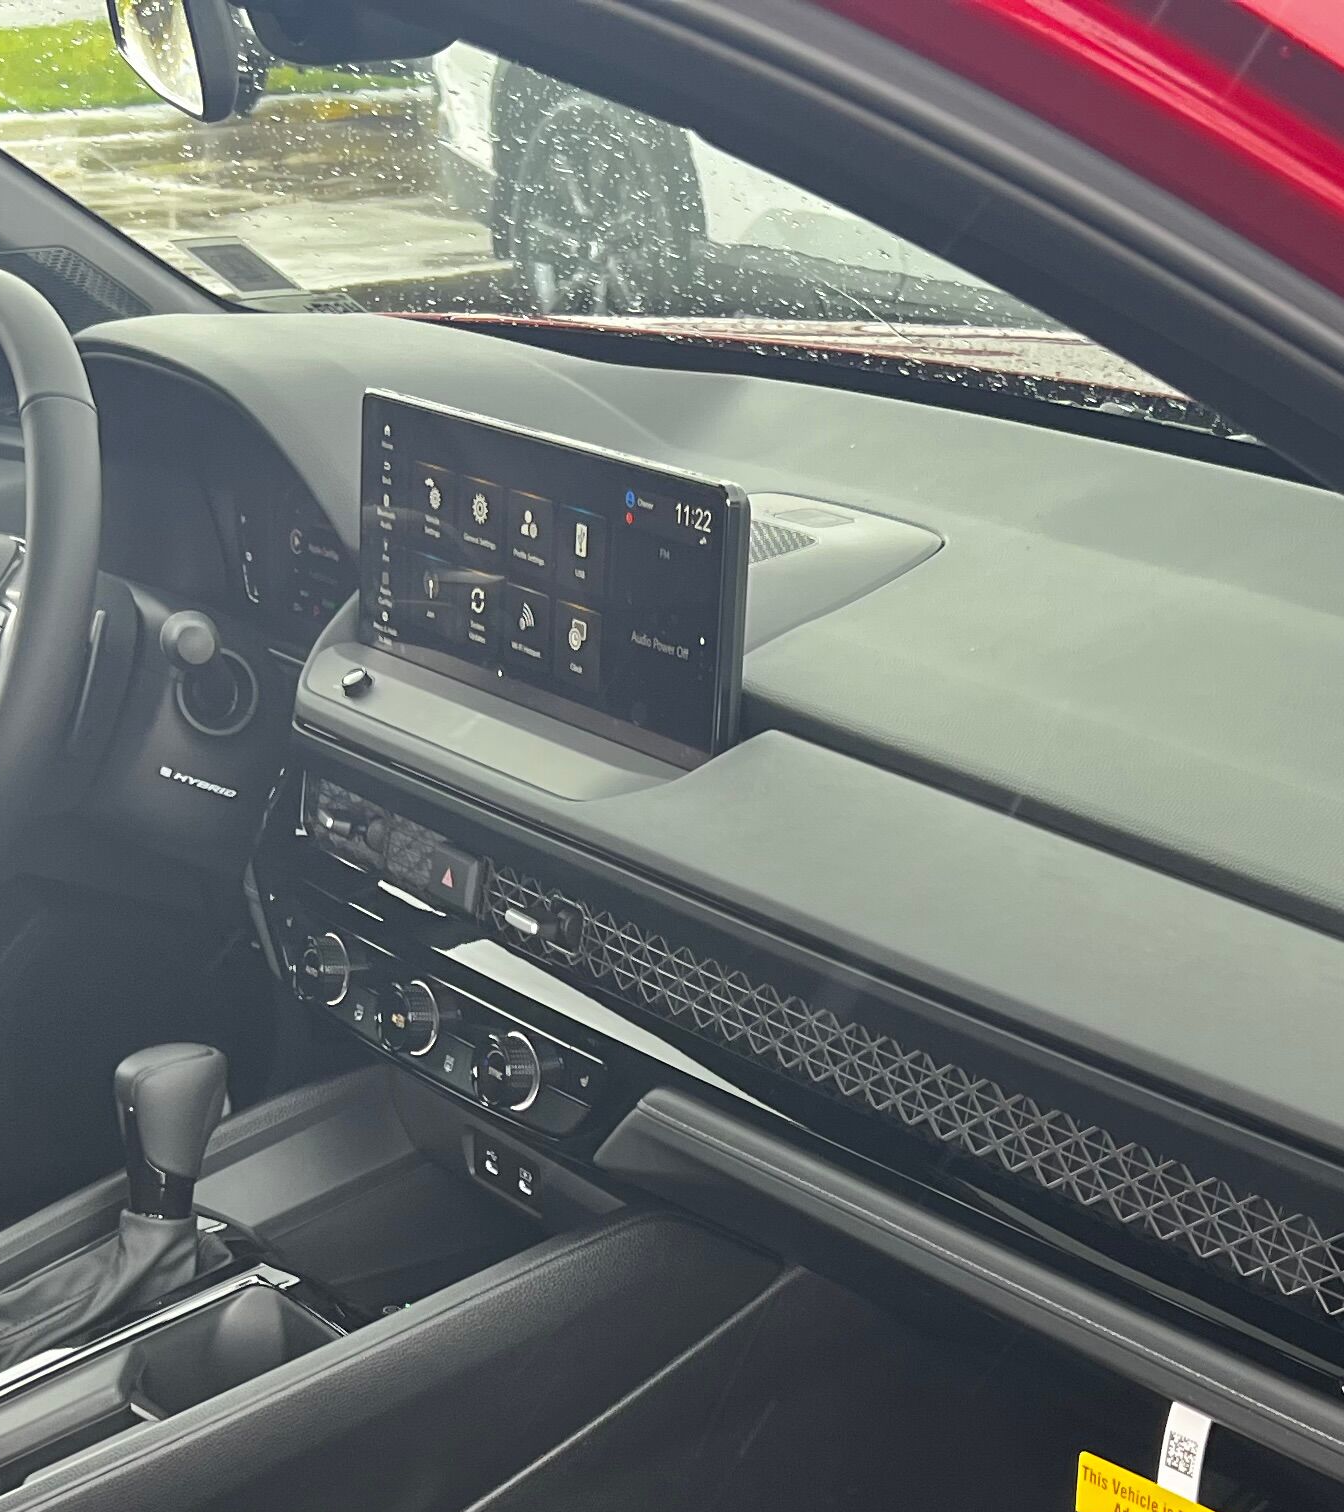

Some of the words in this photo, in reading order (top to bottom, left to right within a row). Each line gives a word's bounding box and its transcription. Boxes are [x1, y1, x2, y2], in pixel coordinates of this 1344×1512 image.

[675, 502, 712, 533] 11:22
[631, 630, 651, 649] Audio
[653, 637, 675, 656] Power
[676, 645, 689, 661] Off
[1082, 1464, 1109, 1490] This
